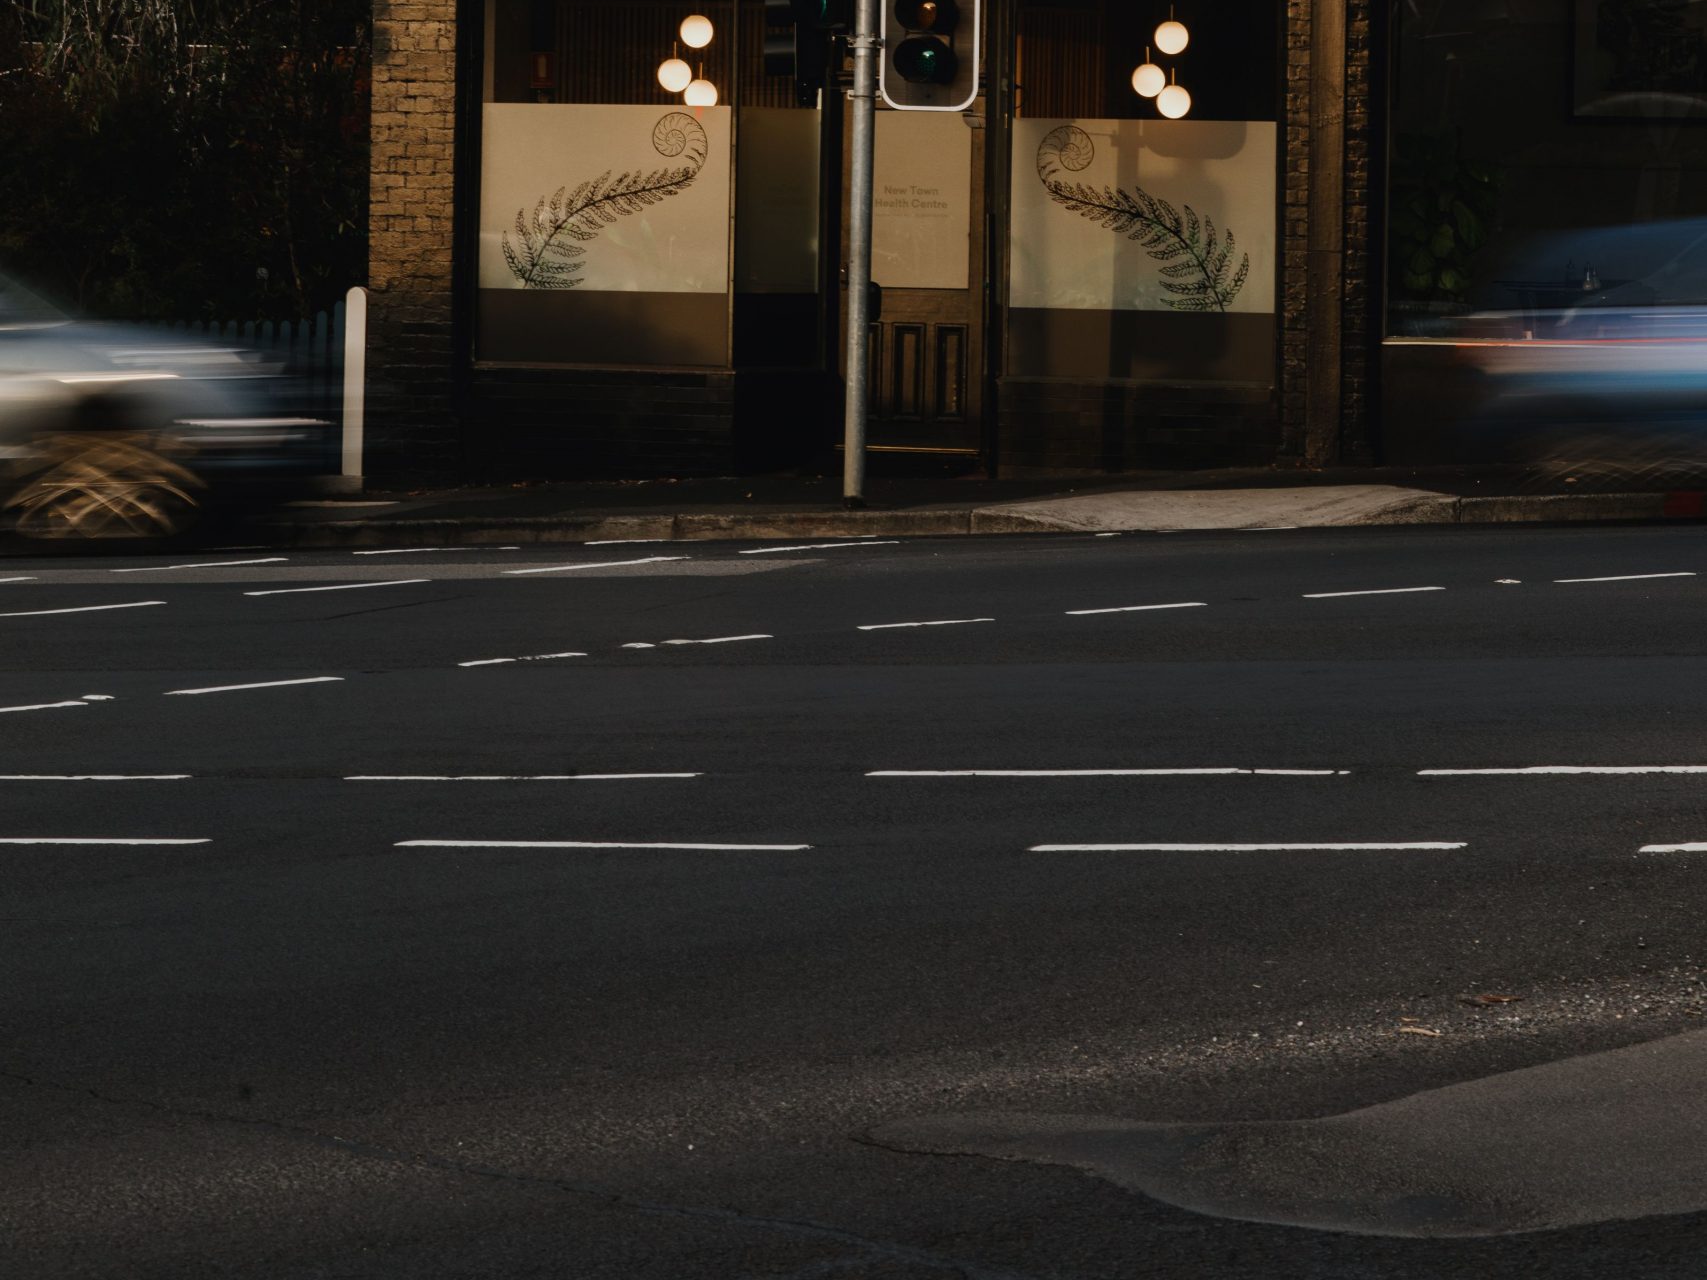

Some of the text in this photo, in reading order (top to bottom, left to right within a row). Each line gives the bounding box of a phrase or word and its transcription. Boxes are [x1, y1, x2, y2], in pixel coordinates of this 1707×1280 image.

[883, 185, 939, 196] New Town
[875, 198, 948, 209] Health Centre
